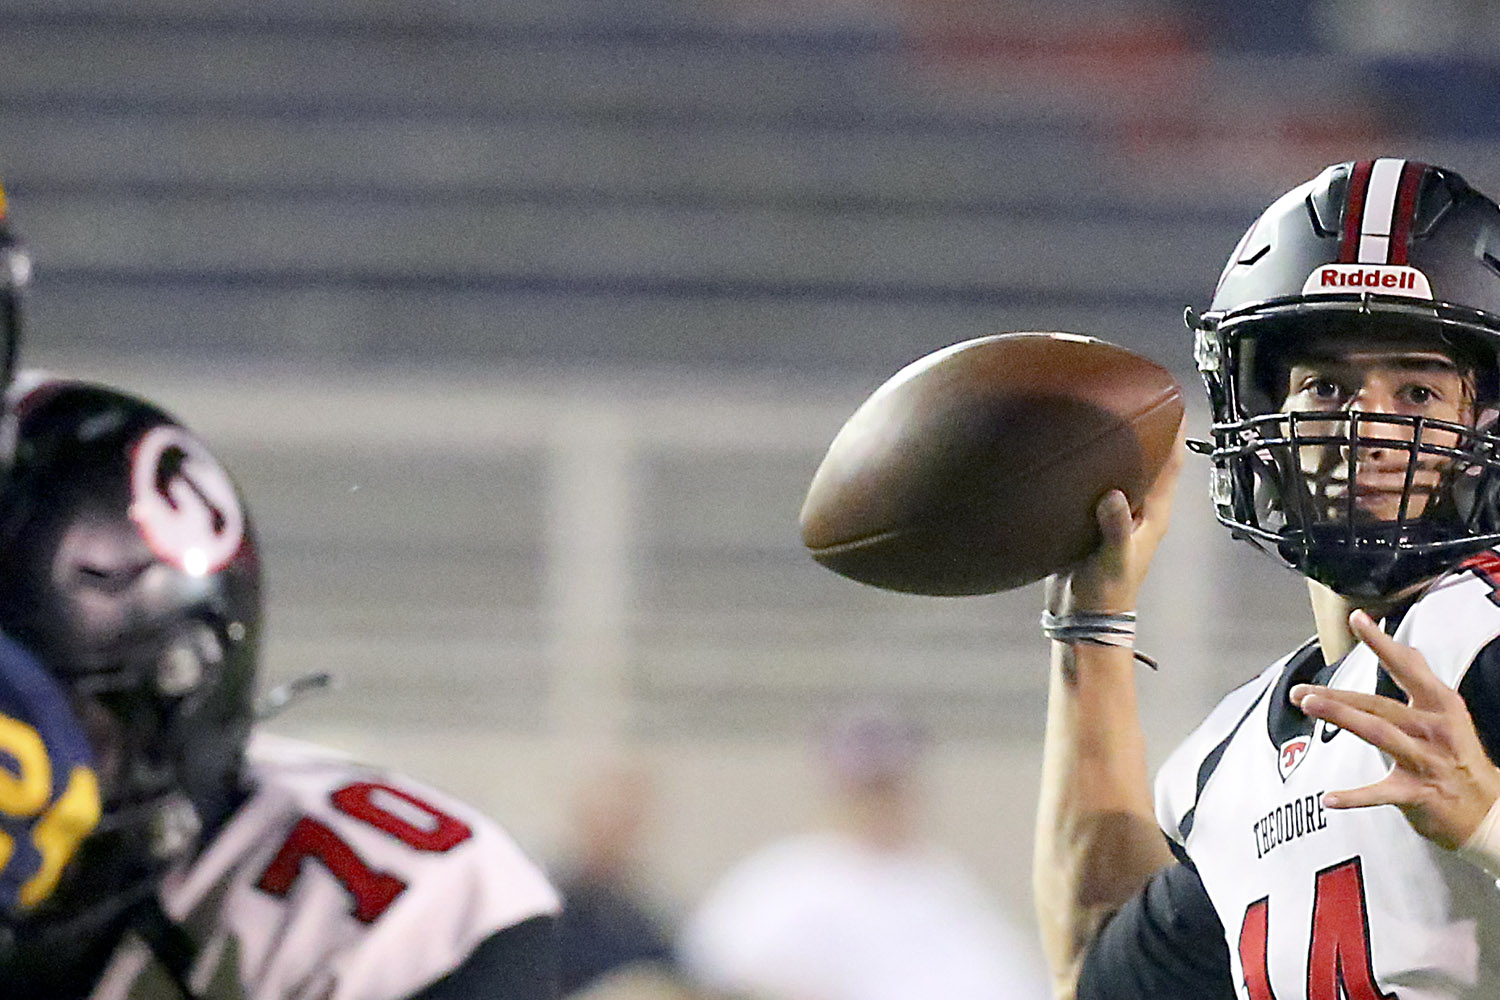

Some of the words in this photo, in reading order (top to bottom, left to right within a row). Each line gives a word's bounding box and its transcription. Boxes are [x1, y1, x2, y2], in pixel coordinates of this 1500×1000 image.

[1321, 269, 1416, 289] Riddell
[1282, 742, 1307, 768] T
[1253, 790, 1328, 859] THEODORE
[256, 781, 473, 926] 70
